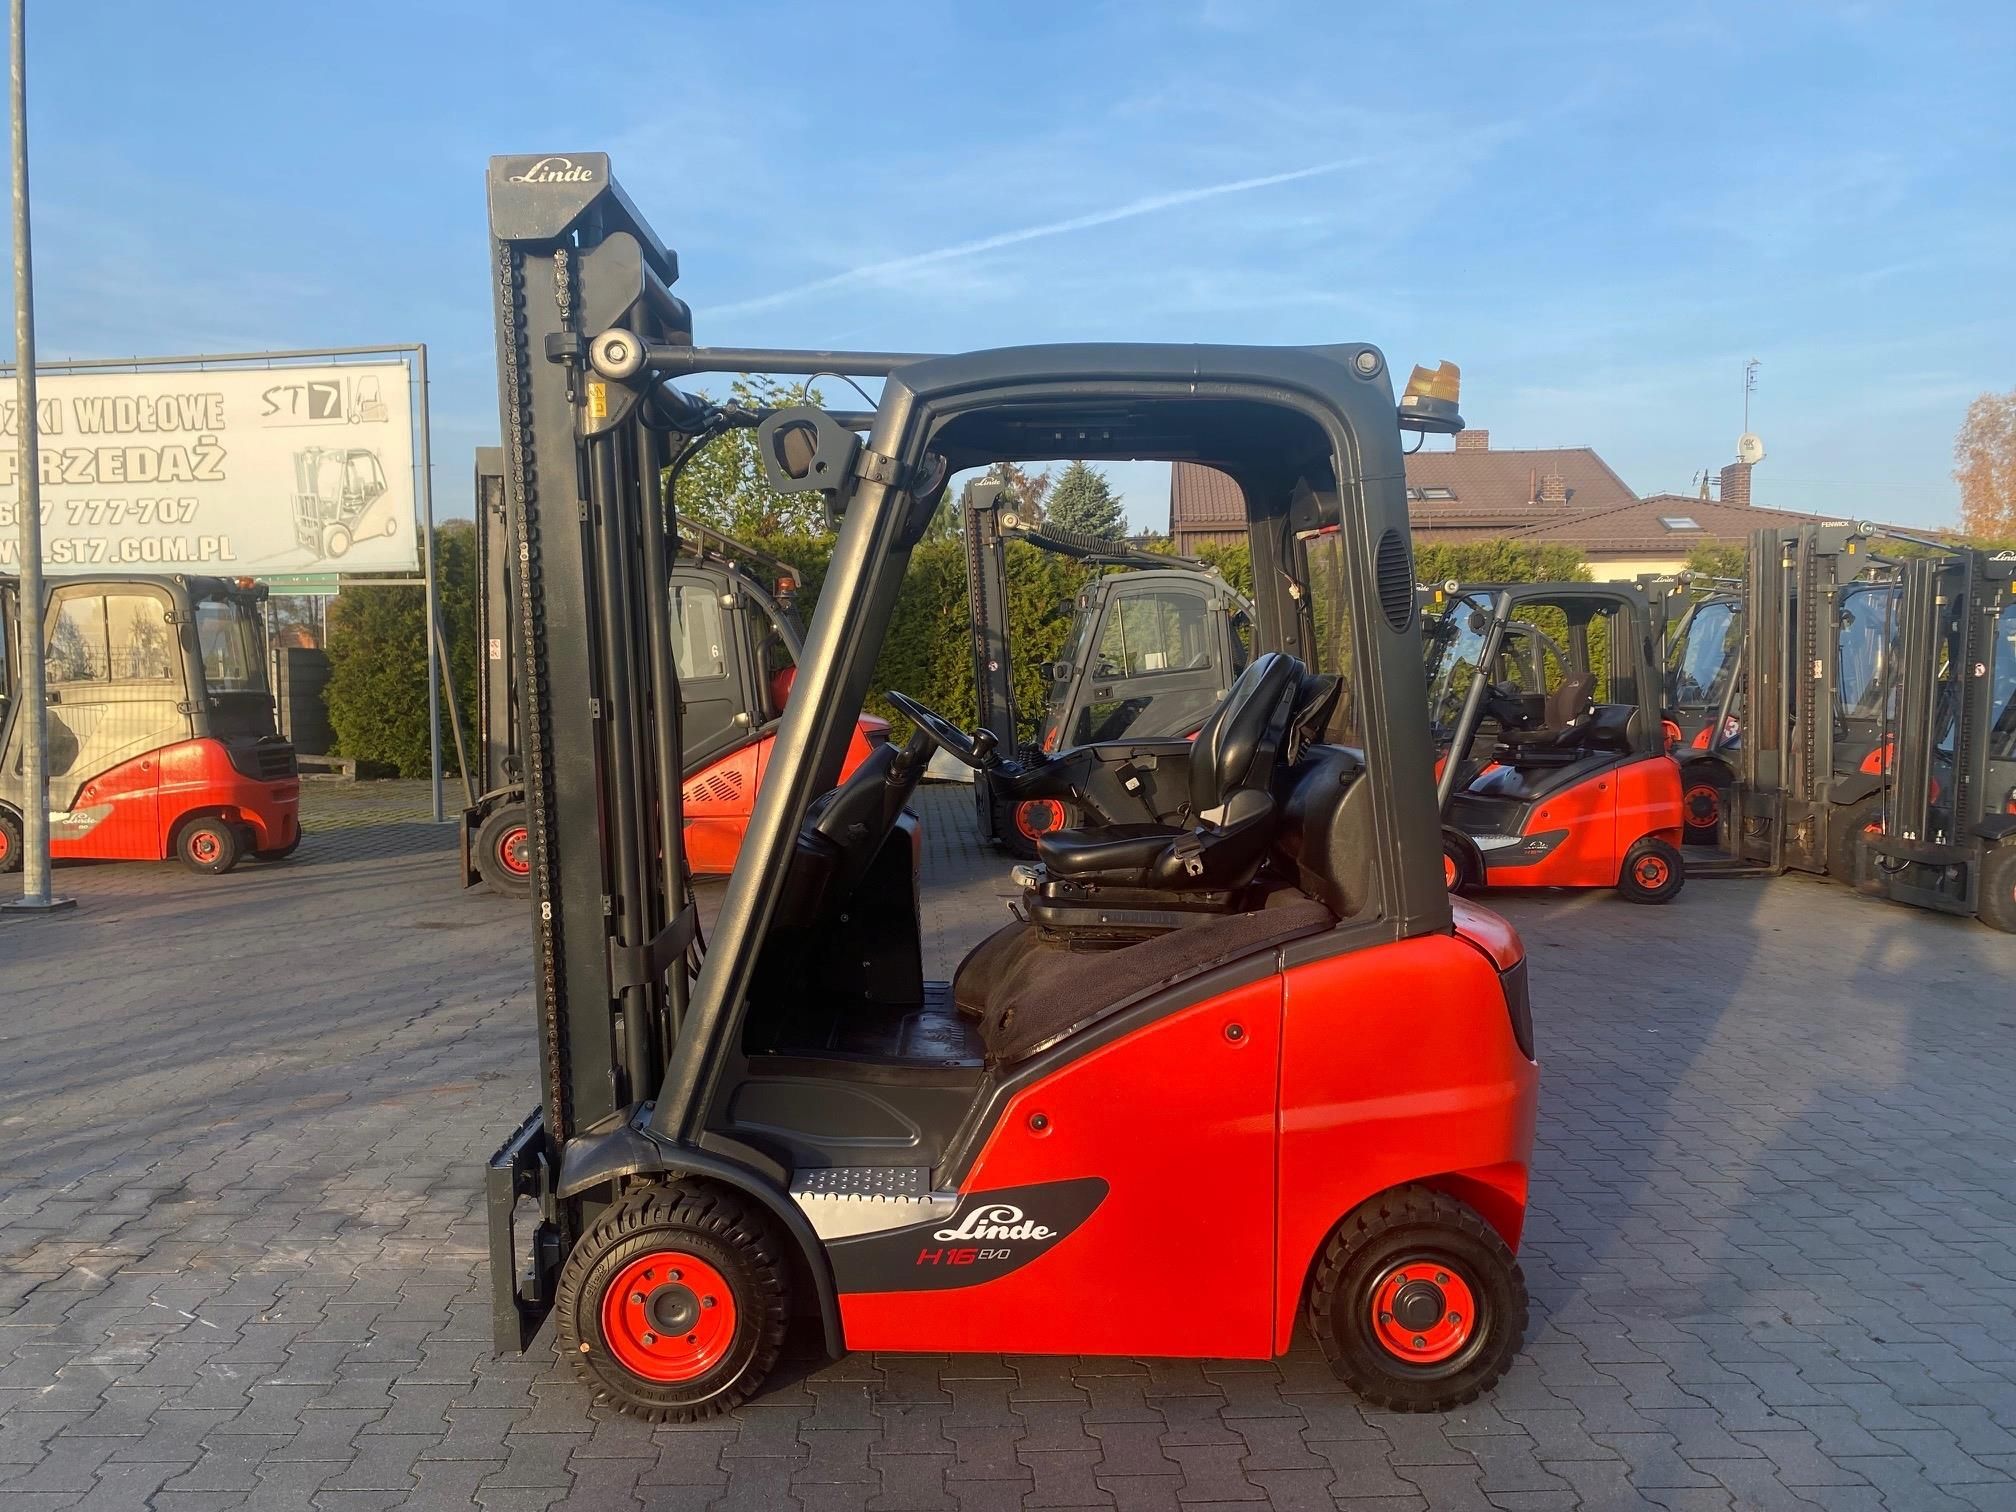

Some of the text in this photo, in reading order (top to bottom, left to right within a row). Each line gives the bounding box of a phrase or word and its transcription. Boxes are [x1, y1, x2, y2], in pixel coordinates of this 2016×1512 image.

[509, 157, 593, 183] Linde
[0, 392, 226, 436] ZKI WIDŁOWE
[261, 381, 341, 419] ST7
[974, 476, 1001, 487] Linde
[66, 497, 201, 526] 777-707
[0, 535, 238, 566] W.ST7.COM.PL
[711, 644, 719, 658] 6
[933, 1204, 1058, 1241] Linde
[977, 1249, 1011, 1260] EVO
